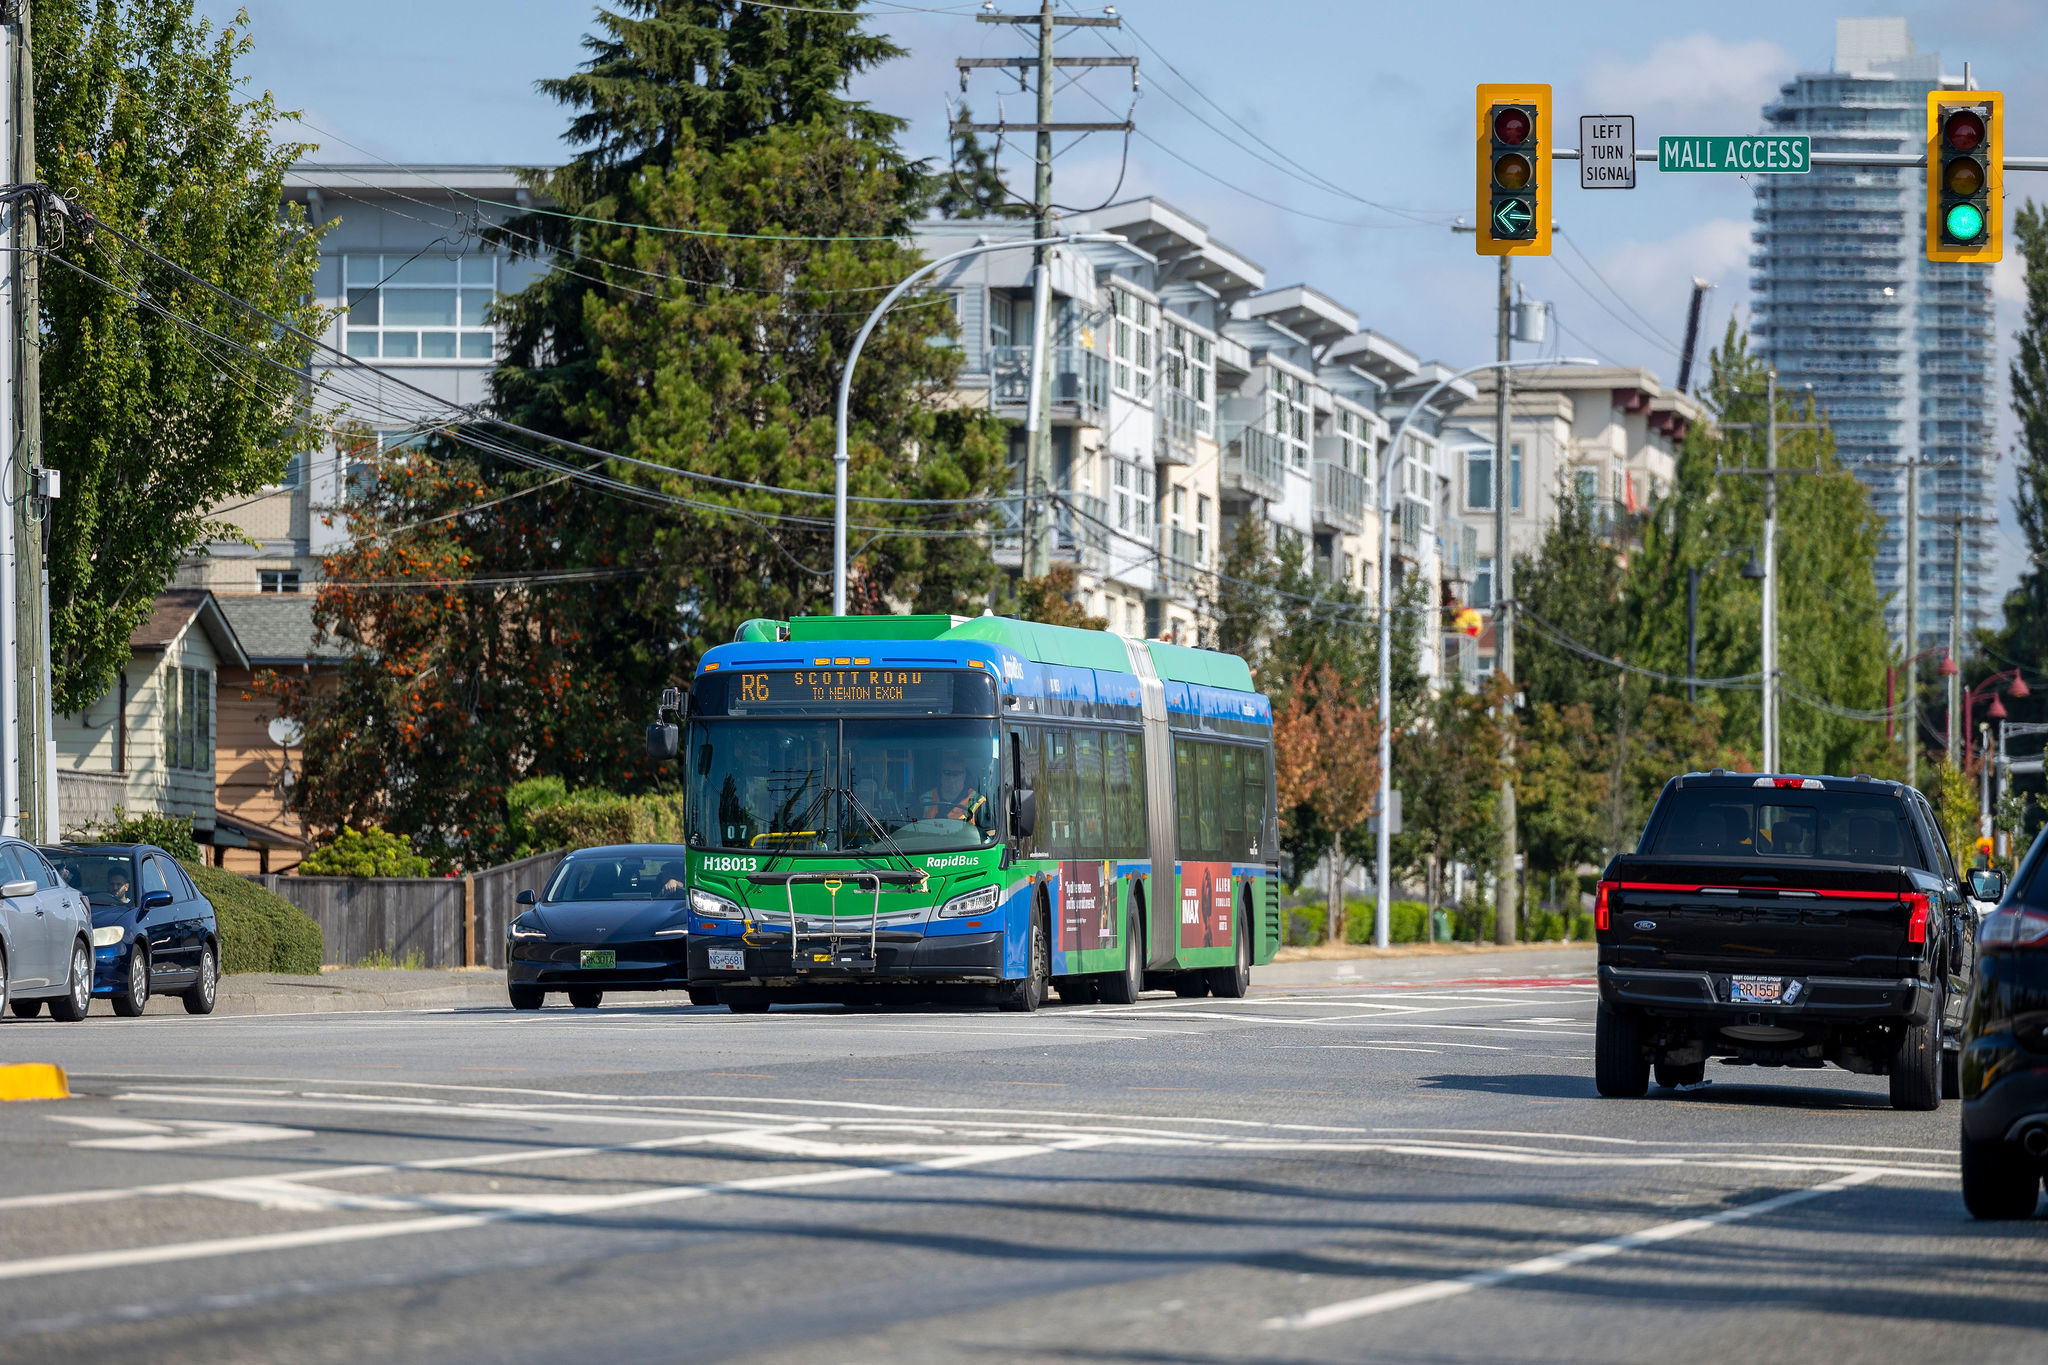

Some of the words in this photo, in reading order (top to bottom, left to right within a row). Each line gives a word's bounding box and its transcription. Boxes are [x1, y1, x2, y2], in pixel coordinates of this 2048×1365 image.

[1593, 125, 1622, 138] LEFT
[1591, 145, 1623, 159] TURN
[1665, 141, 1716, 168] MALL
[1725, 141, 1803, 168] ACCESS
[1587, 166, 1630, 181] SIGNAL
[794, 671, 860, 685] SCOTT
[870, 671, 922, 684] ROAD
[742, 674, 769, 701] R6
[812, 687, 824, 700] TO
[829, 687, 870, 700] NEWTON
[876, 686, 903, 700] EXCH
[704, 856, 757, 871] H18013
[926, 855, 979, 869] RapidBus
[1182, 899, 1199, 924] IMAX
[1738, 983, 1780, 997] RR155H
